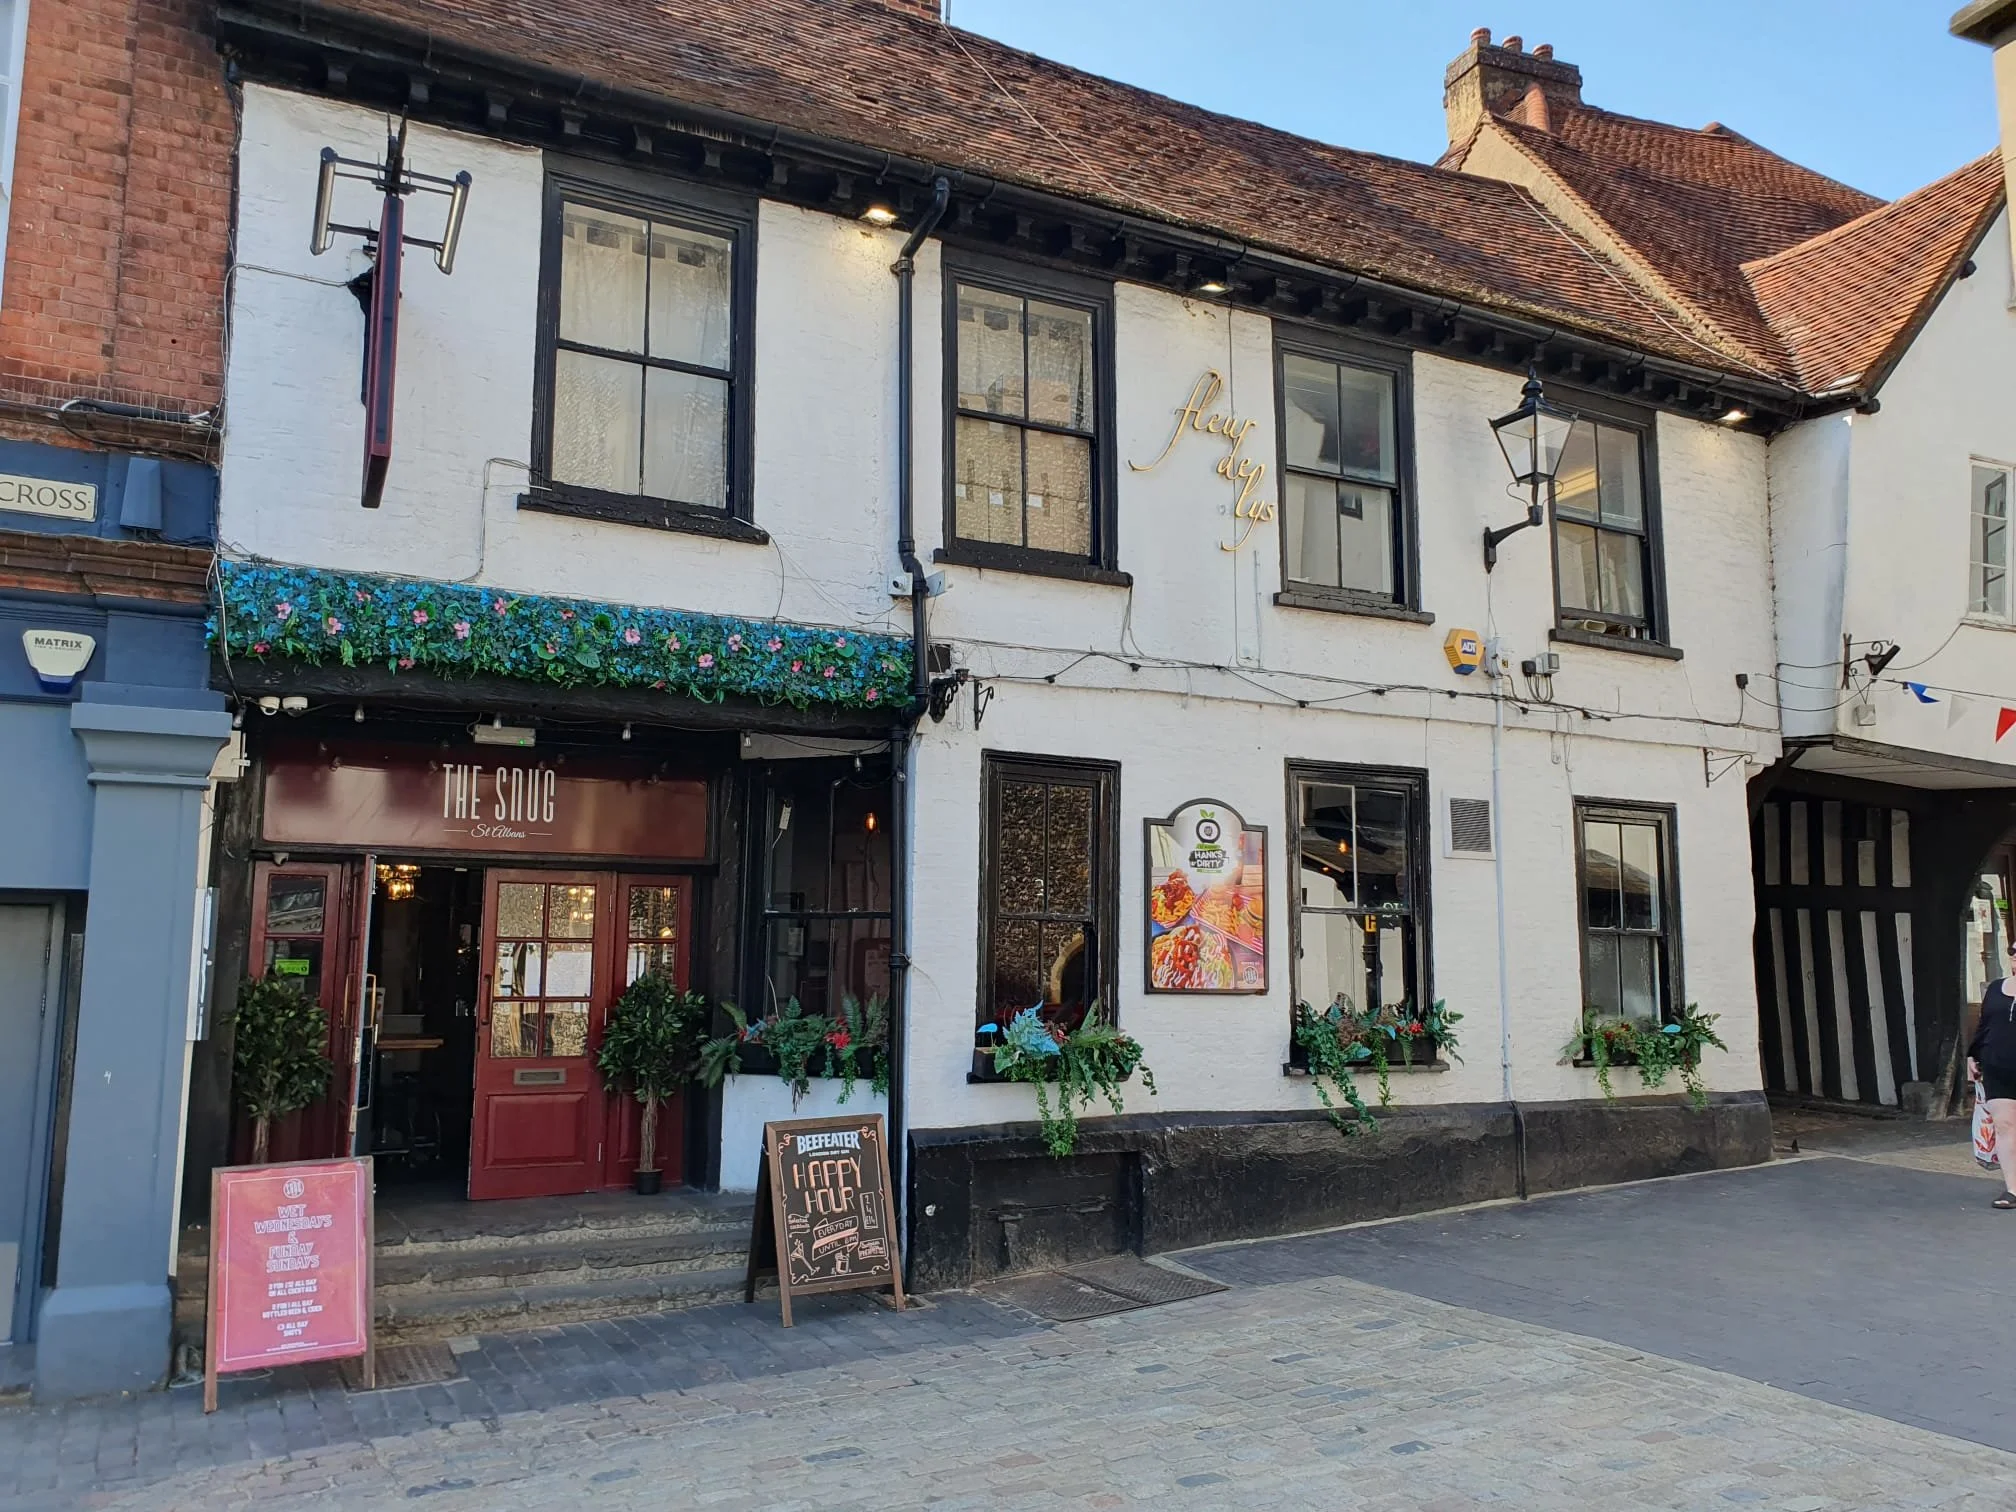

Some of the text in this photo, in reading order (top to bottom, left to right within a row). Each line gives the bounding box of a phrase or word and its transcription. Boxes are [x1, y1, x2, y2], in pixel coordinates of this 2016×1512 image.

[1128, 368, 1257, 472] fleur
[1216, 436, 1251, 481] de
[0, 481, 87, 511] CROSS
[1220, 463, 1276, 551] lys
[34, 637, 83, 649] MATRIX
[1461, 641, 1476, 653] ADT
[443, 763, 555, 823] THE SNUG
[471, 823, 526, 839] St Albans
[1196, 859, 1221, 869] DIRTY
[797, 1131, 861, 1155] BEEFEATER
[792, 1154, 861, 1189] HAPPY
[805, 1186, 855, 1215] HOUR
[277, 1204, 307, 1218] WET
[254, 1215, 333, 1234] WEDNESDAYS
[818, 1220, 853, 1238] EVERYDAY
[818, 1241, 841, 1254] UNTIL
[266, 1255, 320, 1273] SUNDAYS
